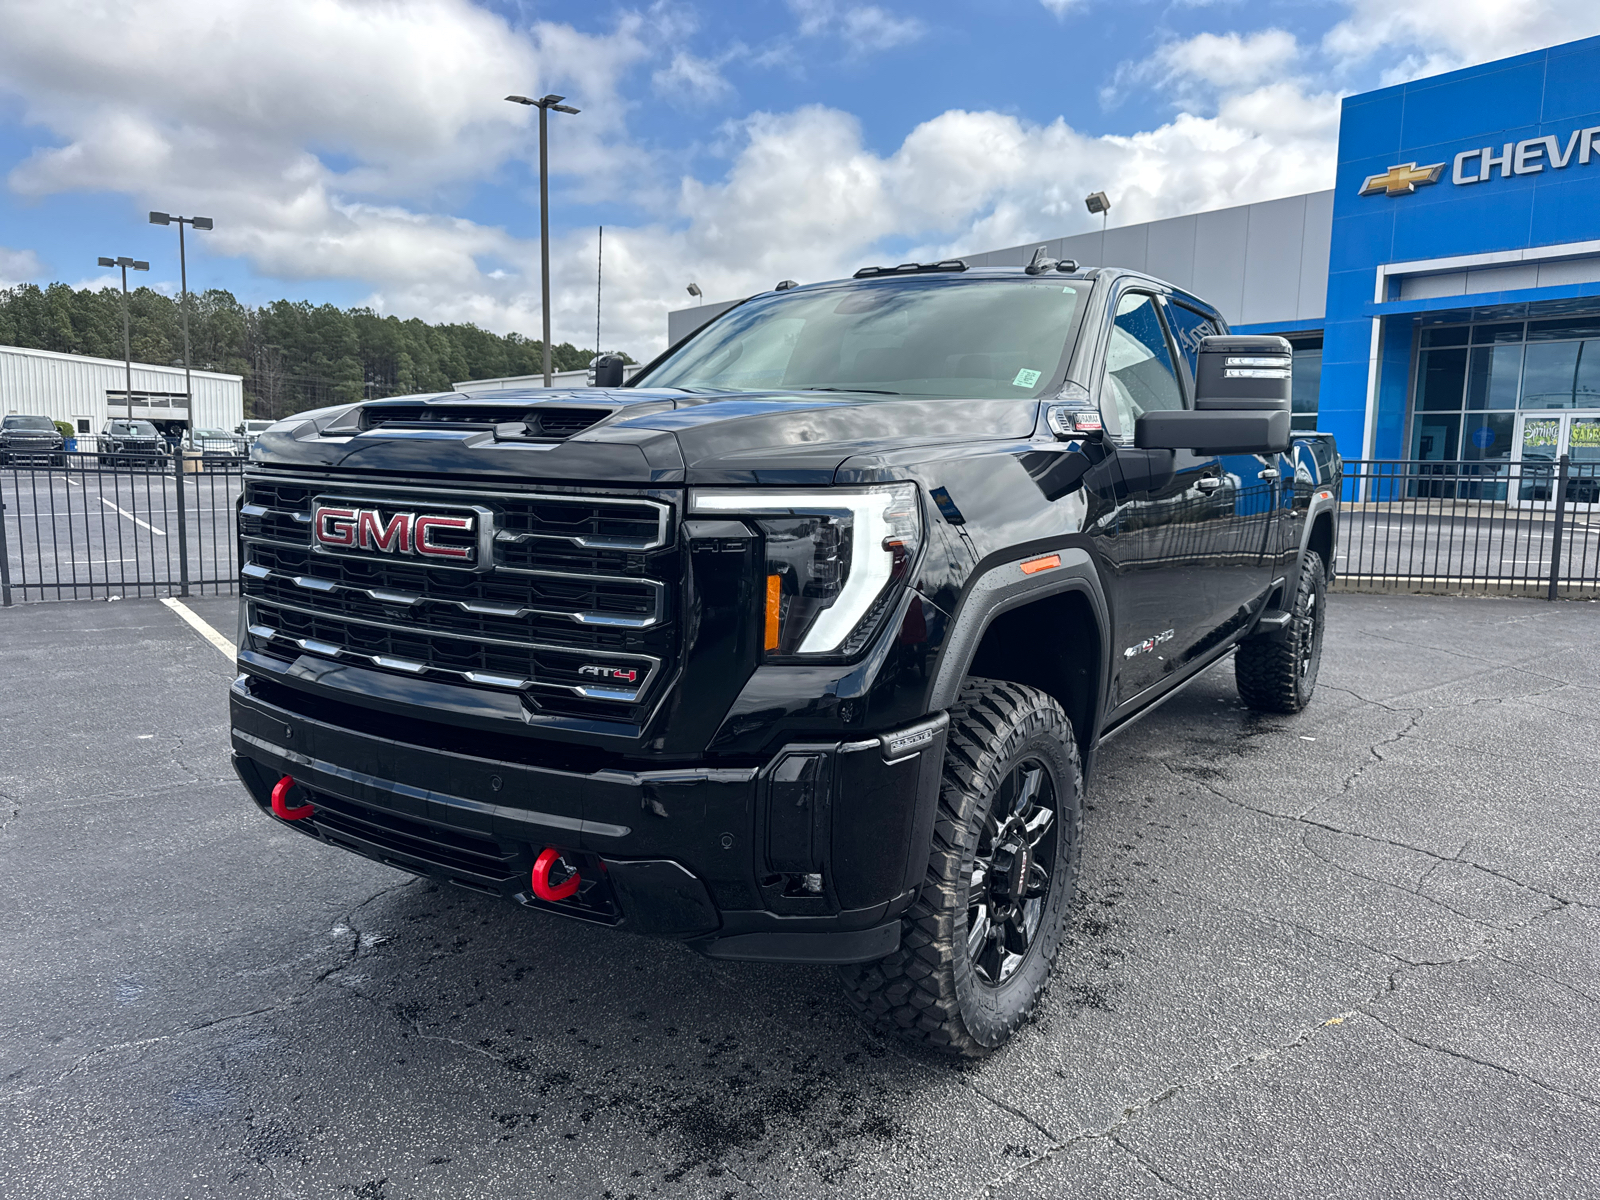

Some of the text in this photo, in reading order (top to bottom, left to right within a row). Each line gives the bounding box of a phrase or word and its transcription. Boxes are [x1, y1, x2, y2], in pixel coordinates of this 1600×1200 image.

[1523, 422, 1559, 442] Spring
[1572, 429, 1600, 442] SALE
[316, 506, 475, 561] GMC
[578, 665, 637, 683] AT4
